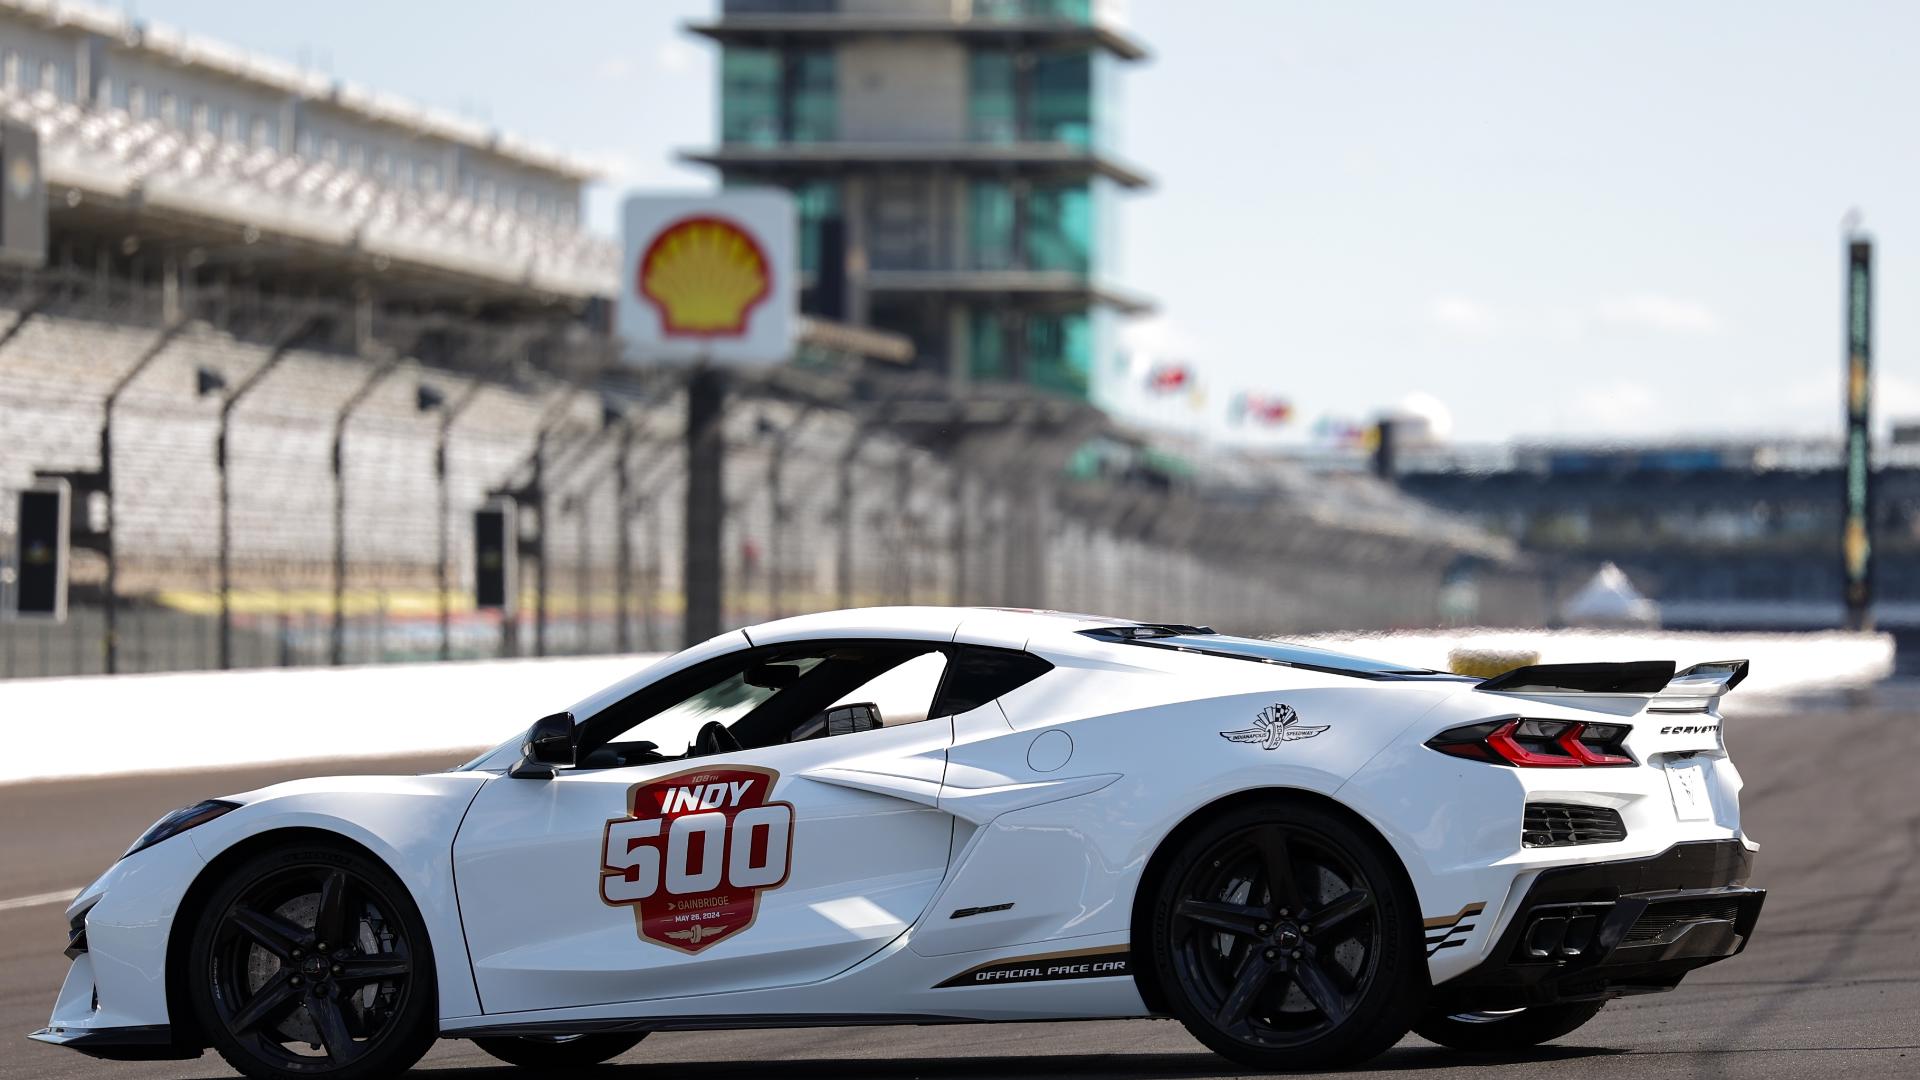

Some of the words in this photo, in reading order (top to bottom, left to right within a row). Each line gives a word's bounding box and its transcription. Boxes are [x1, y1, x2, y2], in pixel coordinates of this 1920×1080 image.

[660, 779, 755, 815] INDY
[604, 806, 790, 901] 500
[677, 896, 730, 910] GAINBRIDGE
[675, 914, 690, 922] MAY
[702, 912, 720, 920] 2024
[975, 968, 1043, 981] OFFICIAL
[1047, 964, 1090, 975] PACE
[1092, 961, 1127, 971] CAR
